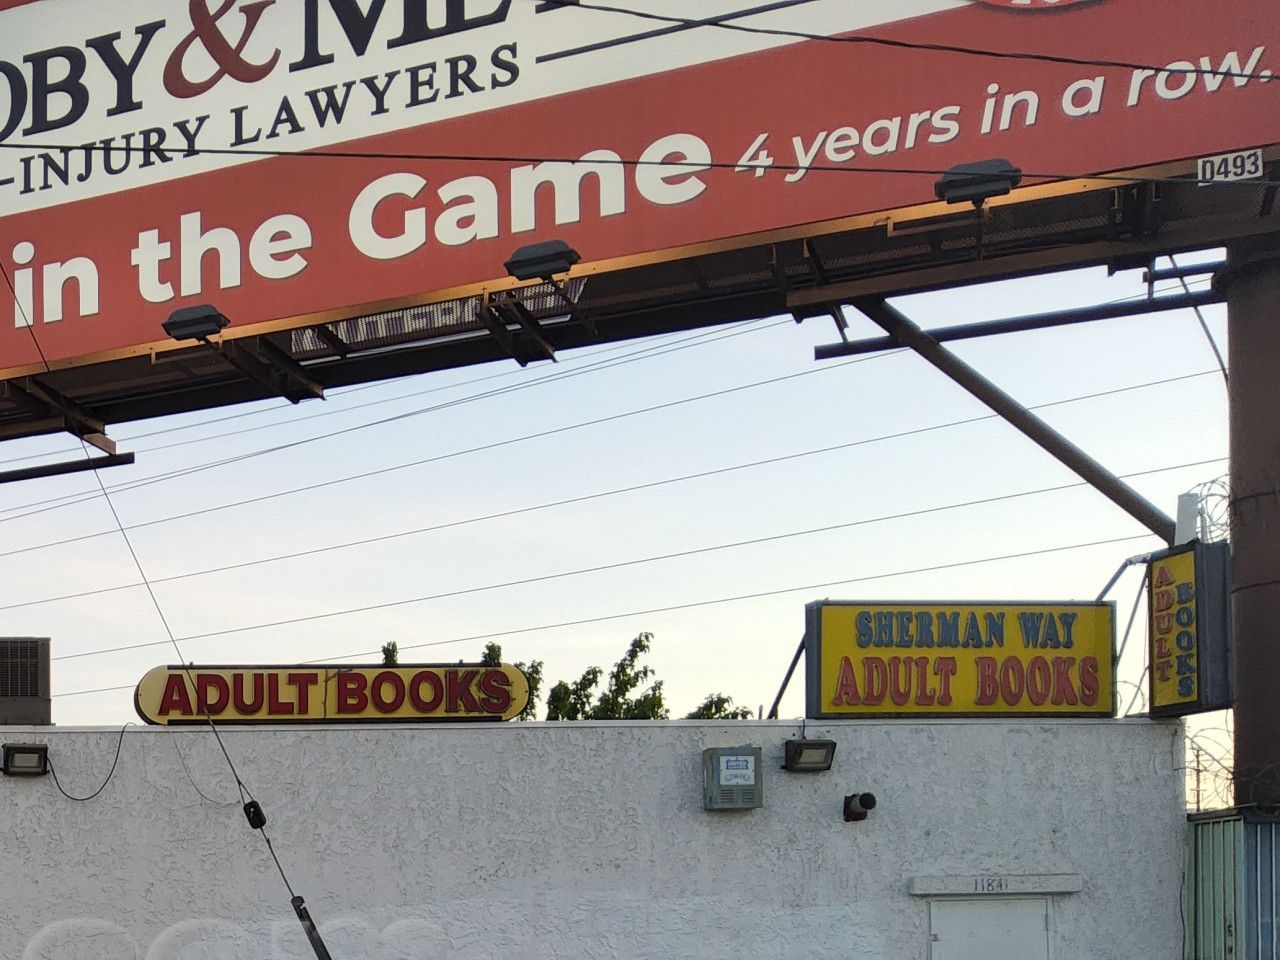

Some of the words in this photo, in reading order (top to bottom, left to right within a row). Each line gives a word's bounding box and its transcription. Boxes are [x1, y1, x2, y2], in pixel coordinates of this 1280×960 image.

[20, 115, 210, 194] INJURY
[232, 42, 520, 145] LAWYERS
[734, 132, 774, 177] 4
[784, 104, 960, 183] years
[980, 82, 1040, 134] in
[1061, 75, 1106, 117] a
[1126, 46, 1274, 108] row.
[14, 242, 100, 328] in
[130, 211, 312, 303] the
[348, 132, 713, 260] Game
[855, 610, 1006, 649] SHERMAN
[1020, 611, 1078, 649] WAY
[158, 672, 318, 716] ADULT
[336, 669, 513, 714] BOOKS
[834, 655, 957, 707] ADULT
[976, 655, 1099, 707] BOOKS
